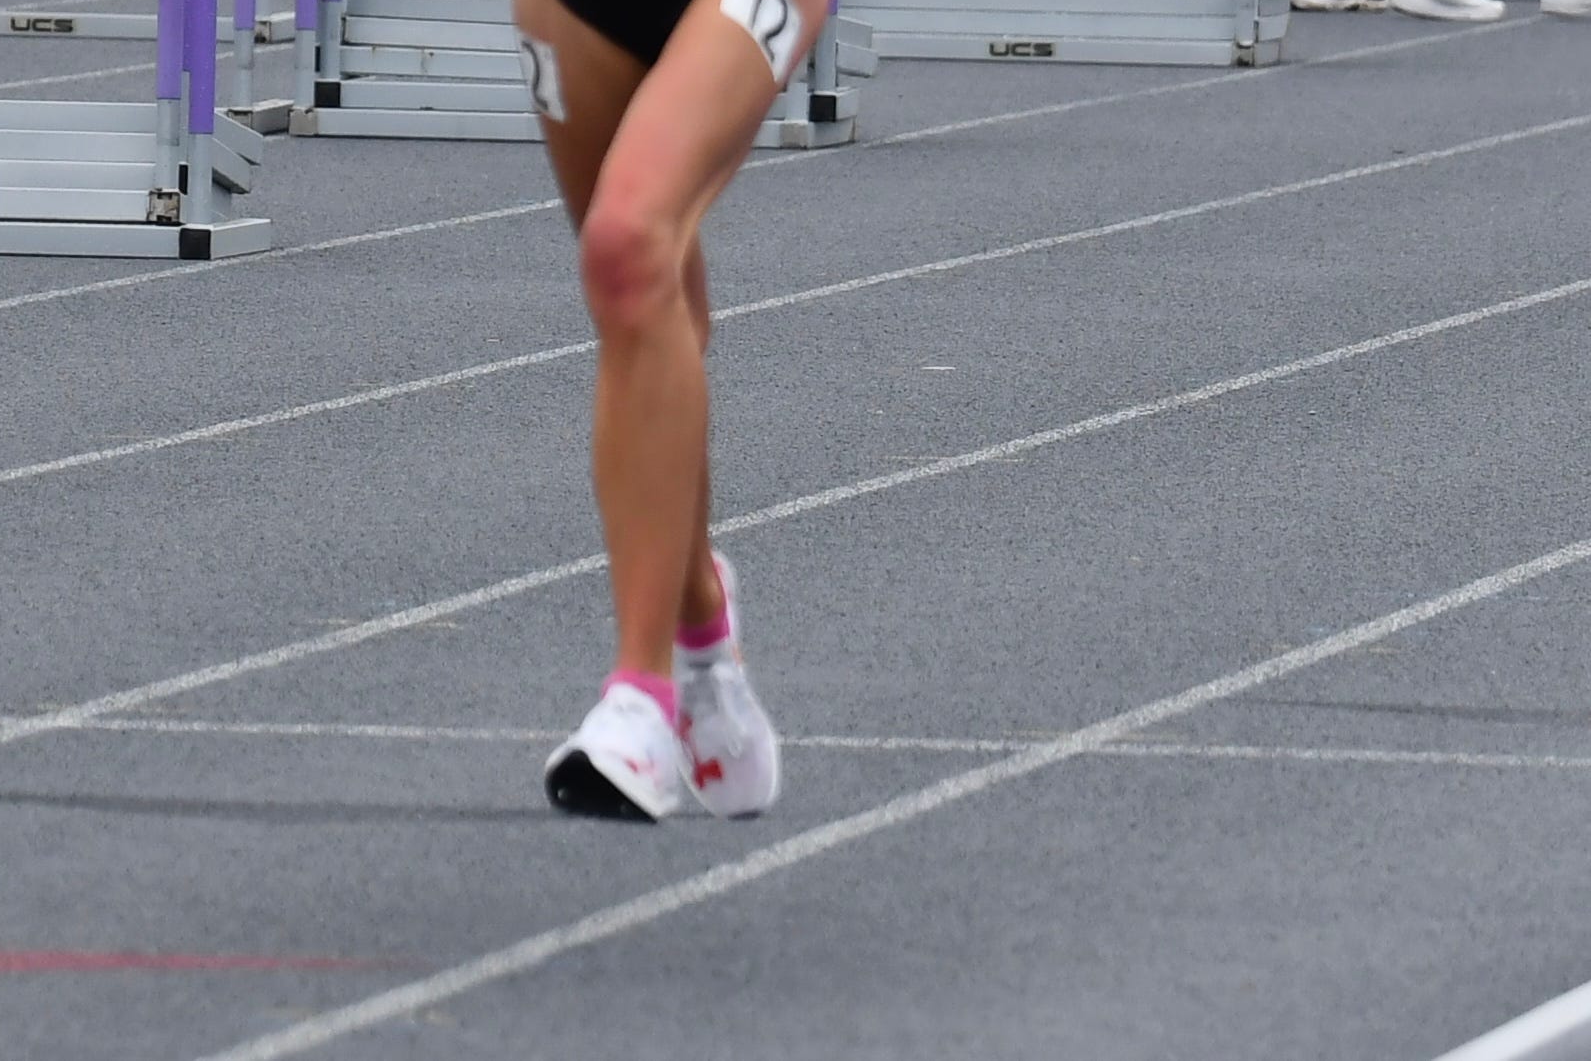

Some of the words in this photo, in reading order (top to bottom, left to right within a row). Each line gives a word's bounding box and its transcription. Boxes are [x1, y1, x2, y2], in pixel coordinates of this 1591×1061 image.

[10, 17, 73, 33] UCS
[989, 42, 1053, 57] UCS
[521, 39, 549, 111] 2
